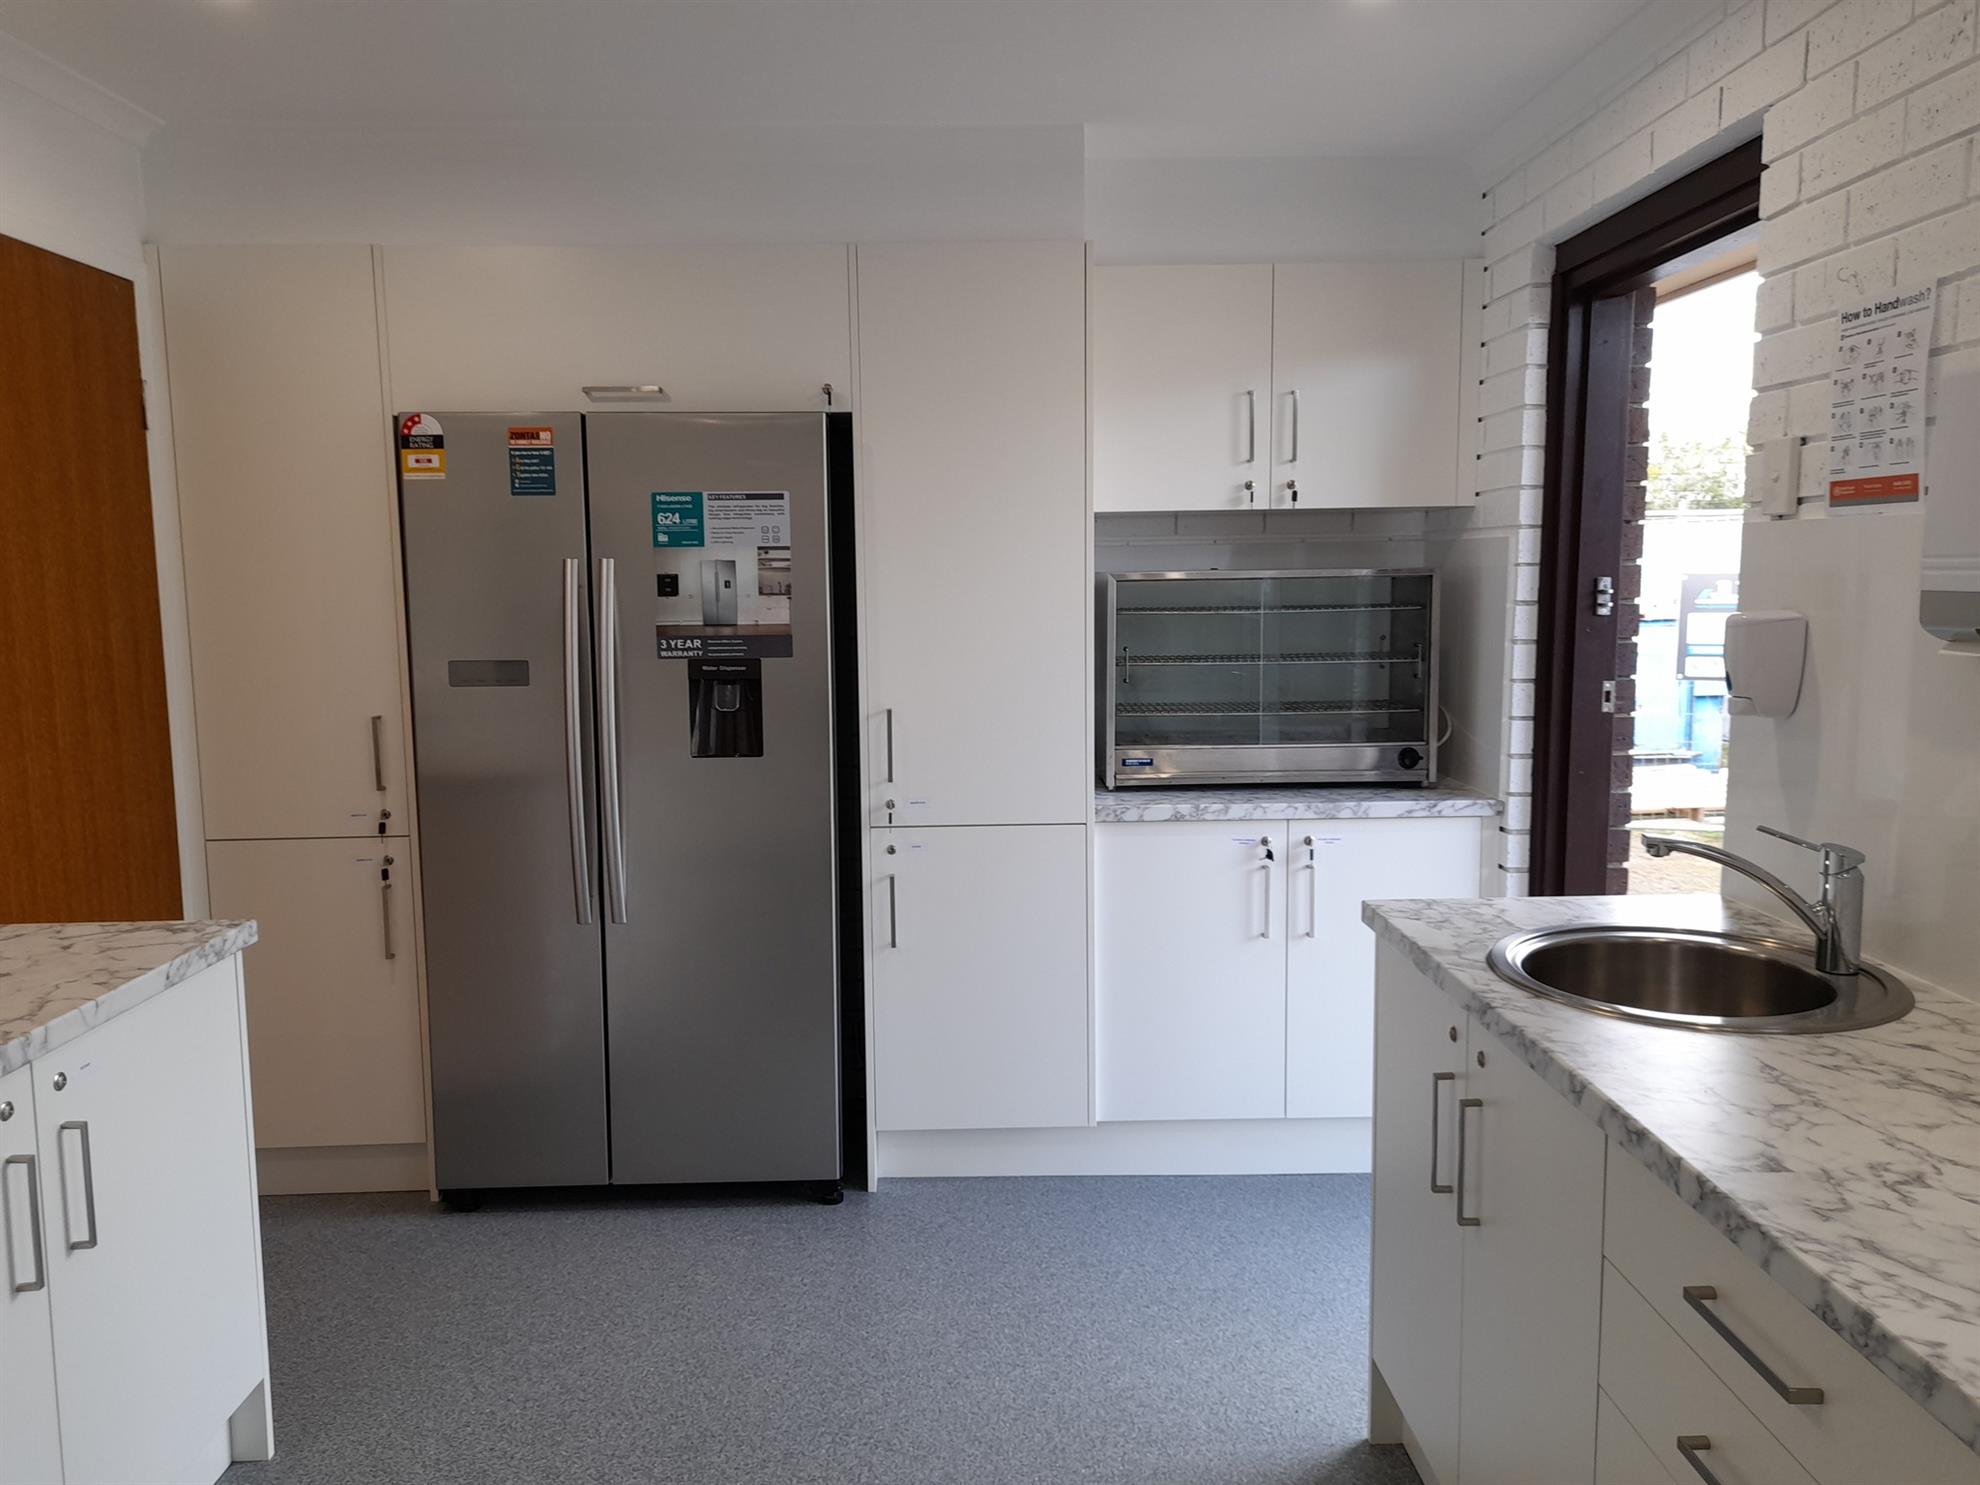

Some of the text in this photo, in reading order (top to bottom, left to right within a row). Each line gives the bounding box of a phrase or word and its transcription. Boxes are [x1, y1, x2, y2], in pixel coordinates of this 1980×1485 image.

[1841, 288, 1932, 324] How to Handwash?
[656, 494, 692, 502] Hisense
[657, 512, 681, 525] 624
[660, 639, 667, 649] 3
[669, 639, 702, 648] YEAR
